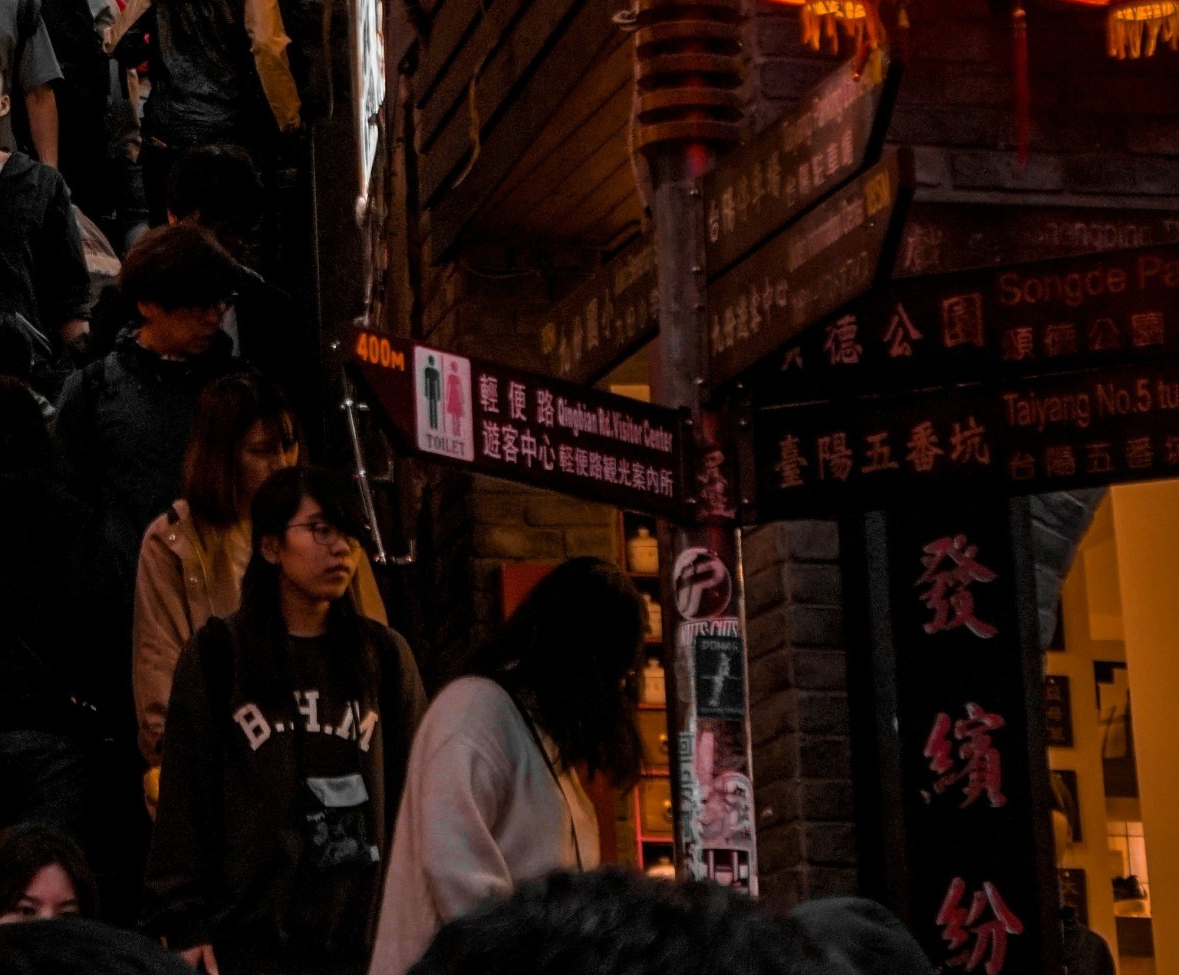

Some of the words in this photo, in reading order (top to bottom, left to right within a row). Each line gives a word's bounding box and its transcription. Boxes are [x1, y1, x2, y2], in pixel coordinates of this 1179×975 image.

[997, 263, 1127, 308] Songde
[1002, 390, 1092, 433] Taiyang
[426, 433, 466, 456] TOILET
